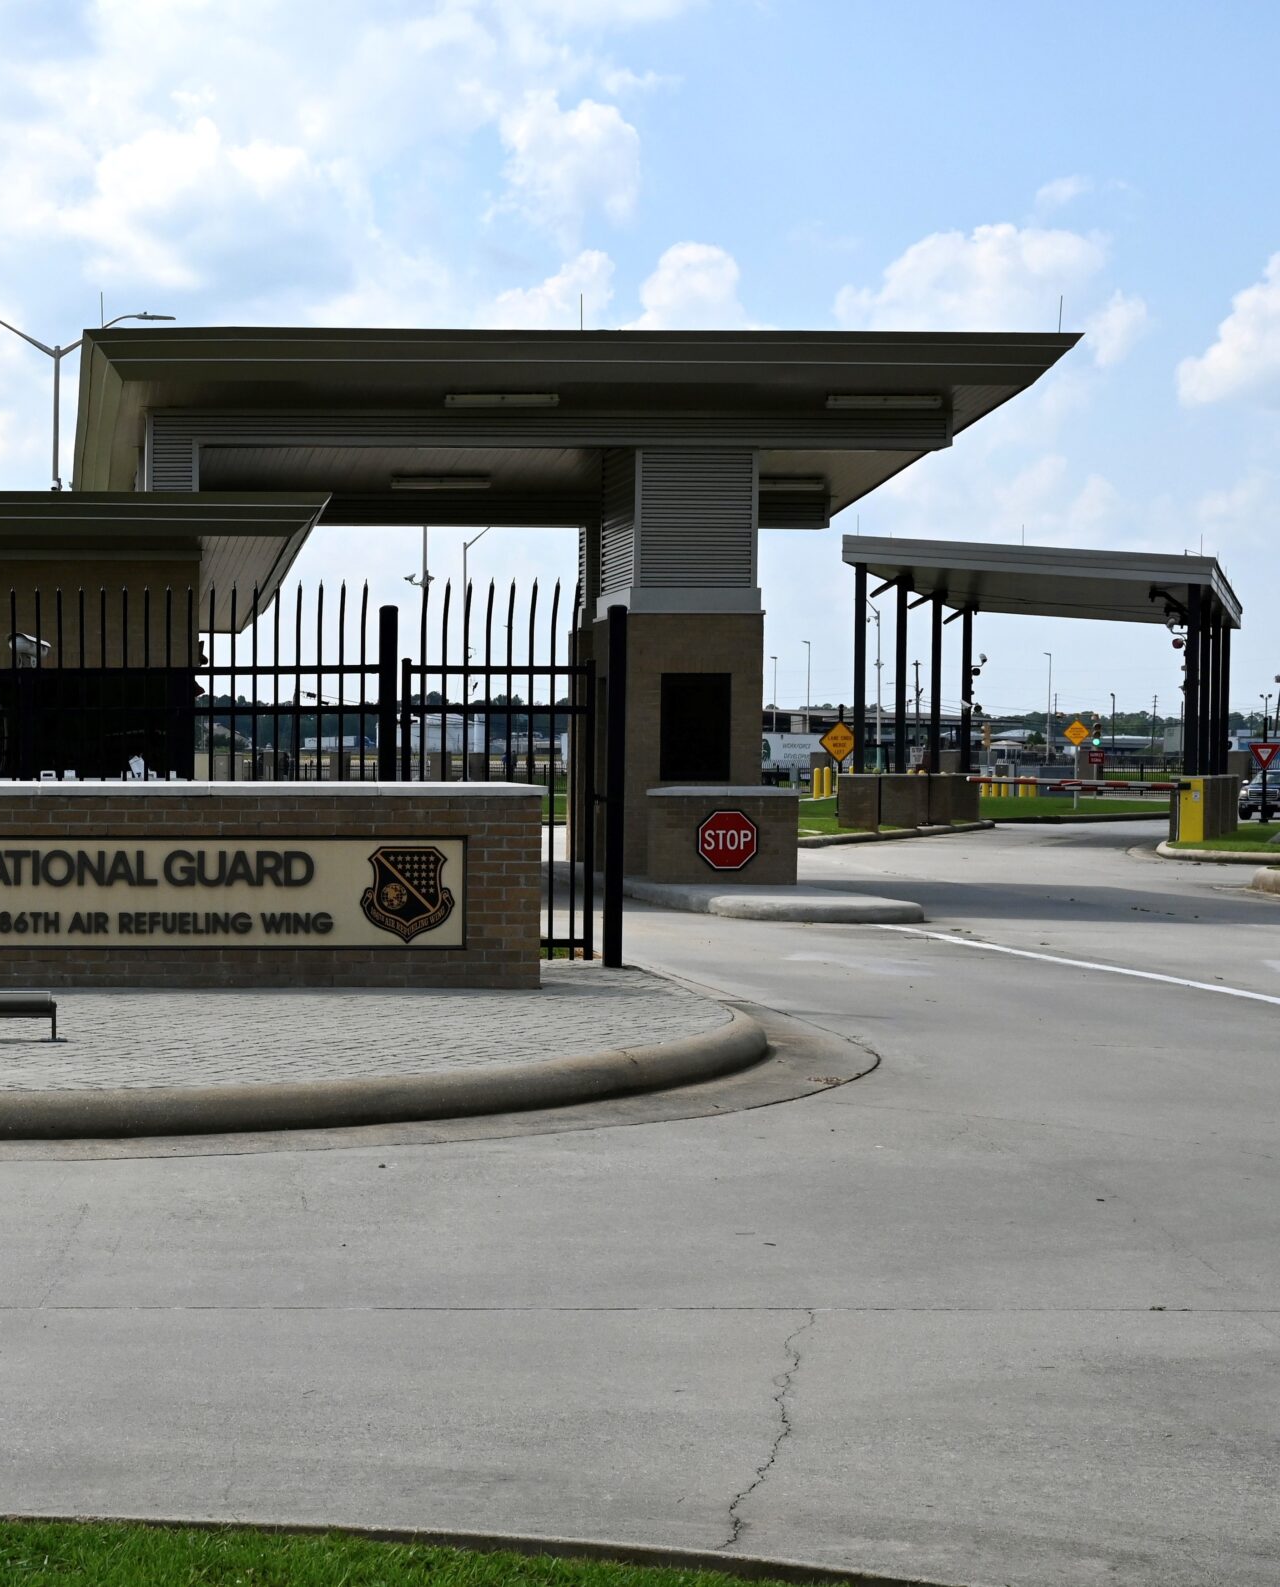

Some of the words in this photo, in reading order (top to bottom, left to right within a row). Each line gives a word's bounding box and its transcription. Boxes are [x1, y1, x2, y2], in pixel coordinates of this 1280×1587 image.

[703, 829, 752, 850] STOP
[162, 849, 315, 889] GUARD
[67, 911, 110, 935] AIR
[118, 911, 253, 936] REFUELING
[260, 911, 334, 936] WING
[385, 917, 396, 928] AIR
[429, 907, 446, 924] WING
